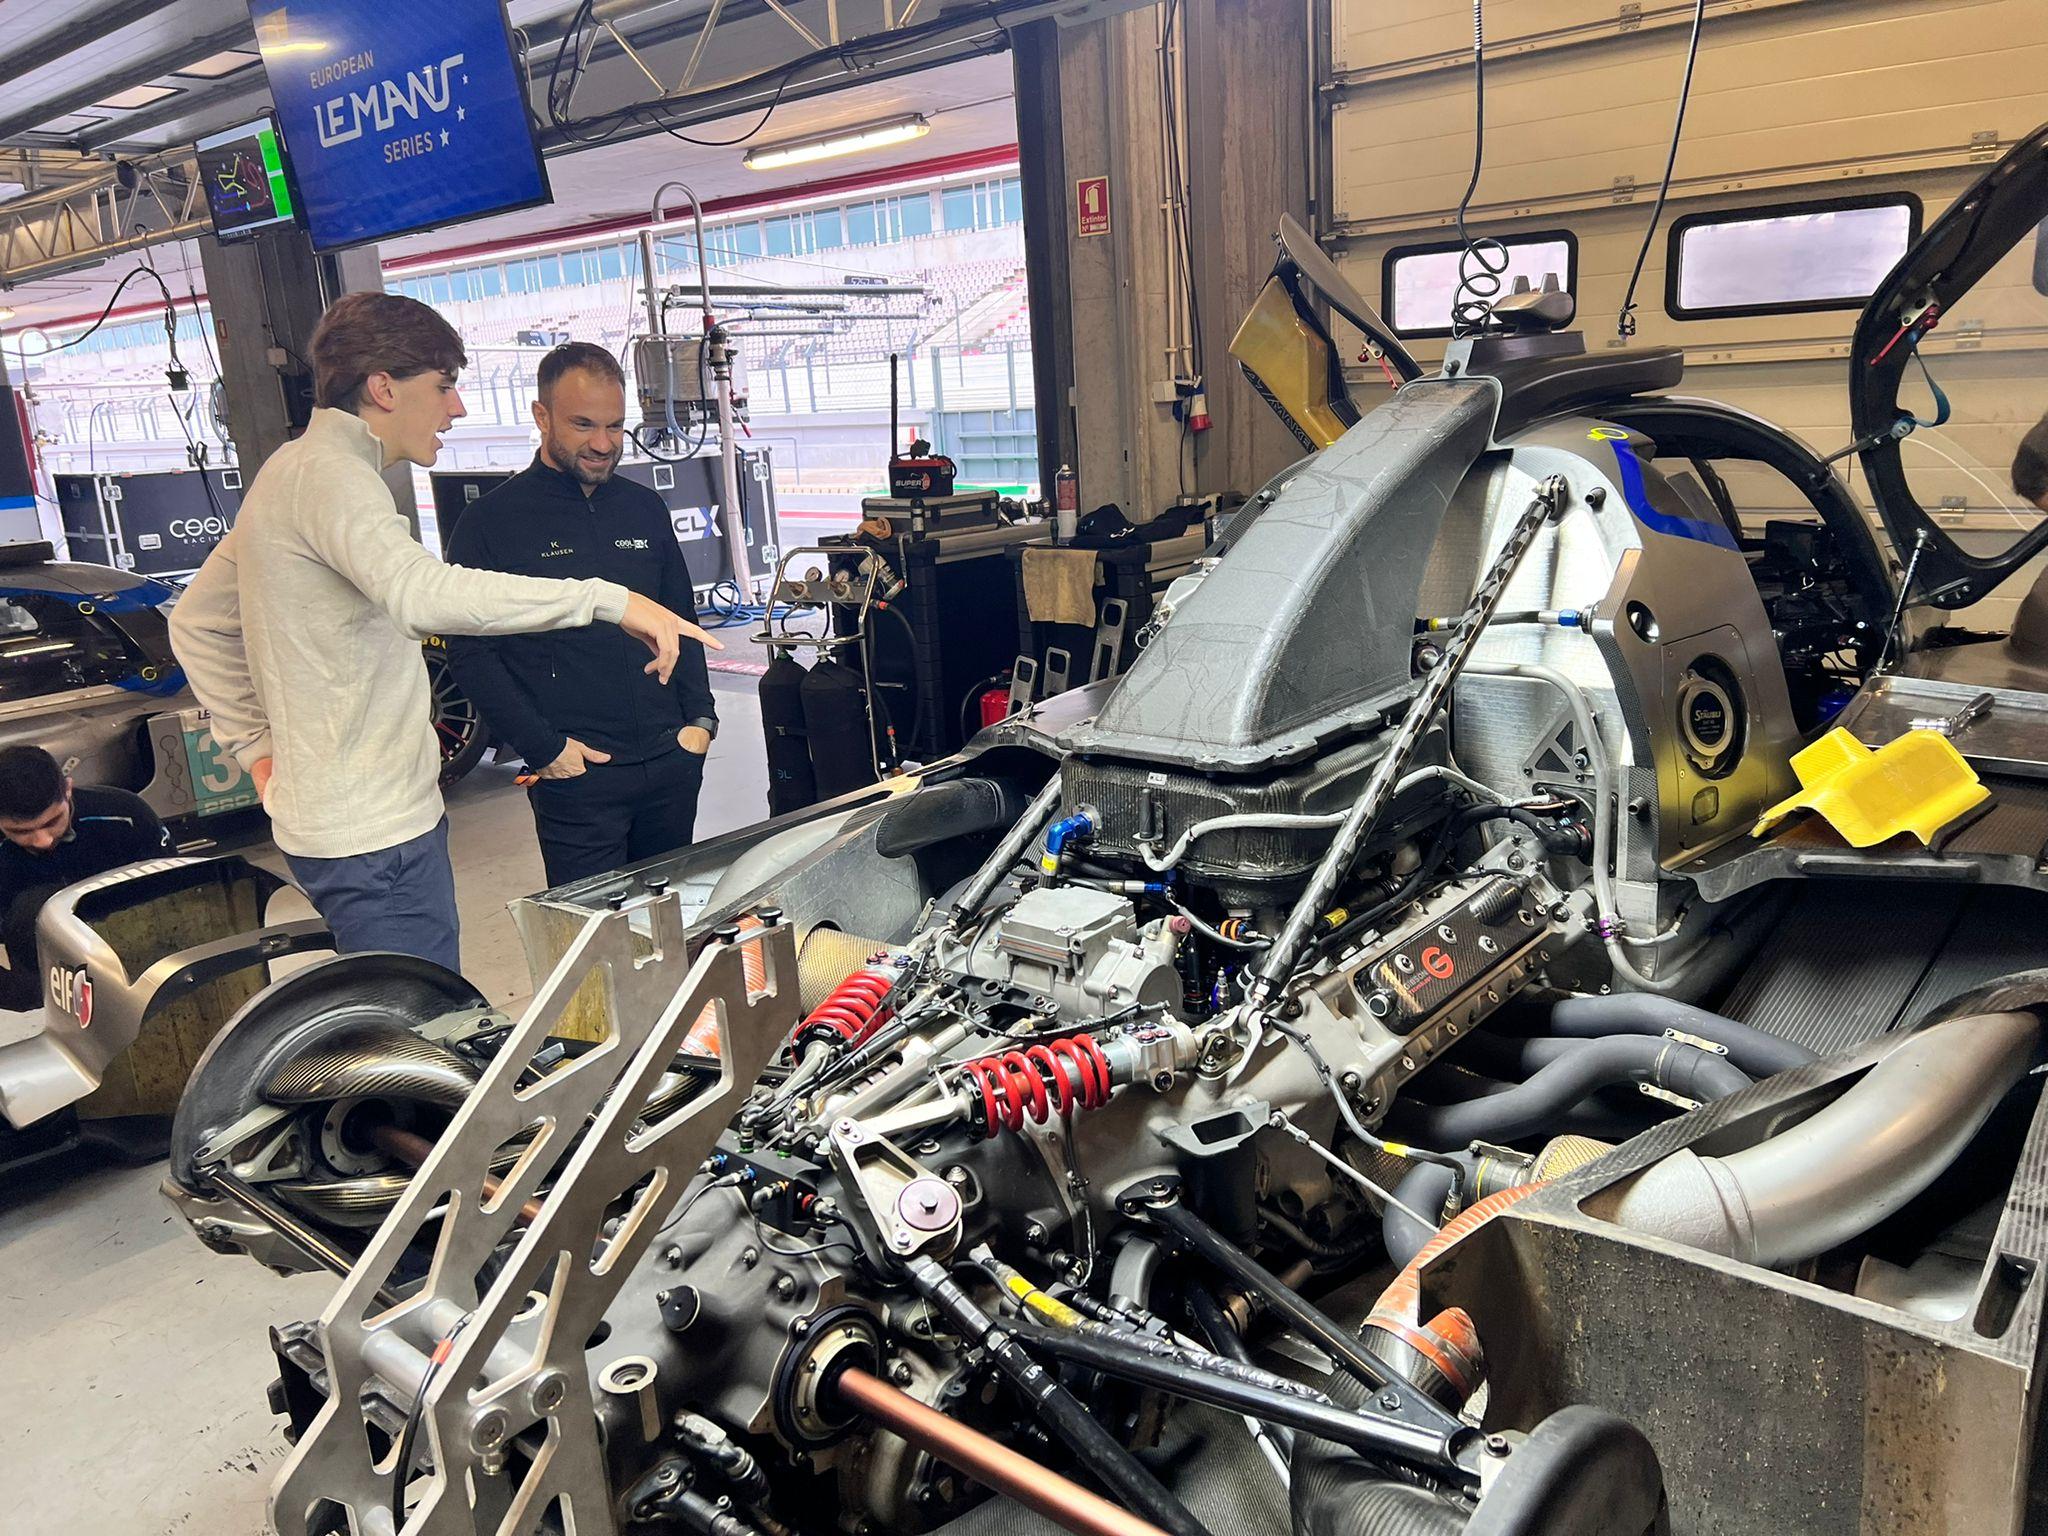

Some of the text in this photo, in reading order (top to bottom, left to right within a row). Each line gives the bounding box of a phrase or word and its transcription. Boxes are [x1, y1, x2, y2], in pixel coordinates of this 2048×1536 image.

[310, 50, 375, 90] EUROPEAN
[384, 131, 434, 164] SERIES
[169, 516, 231, 539] COOL
[674, 504, 723, 538] CLX
[183, 535, 221, 545] RACIN
[541, 548, 574, 558] KLAUSEN
[1421, 946, 1455, 980] G
[50, 966, 73, 1014] elf
